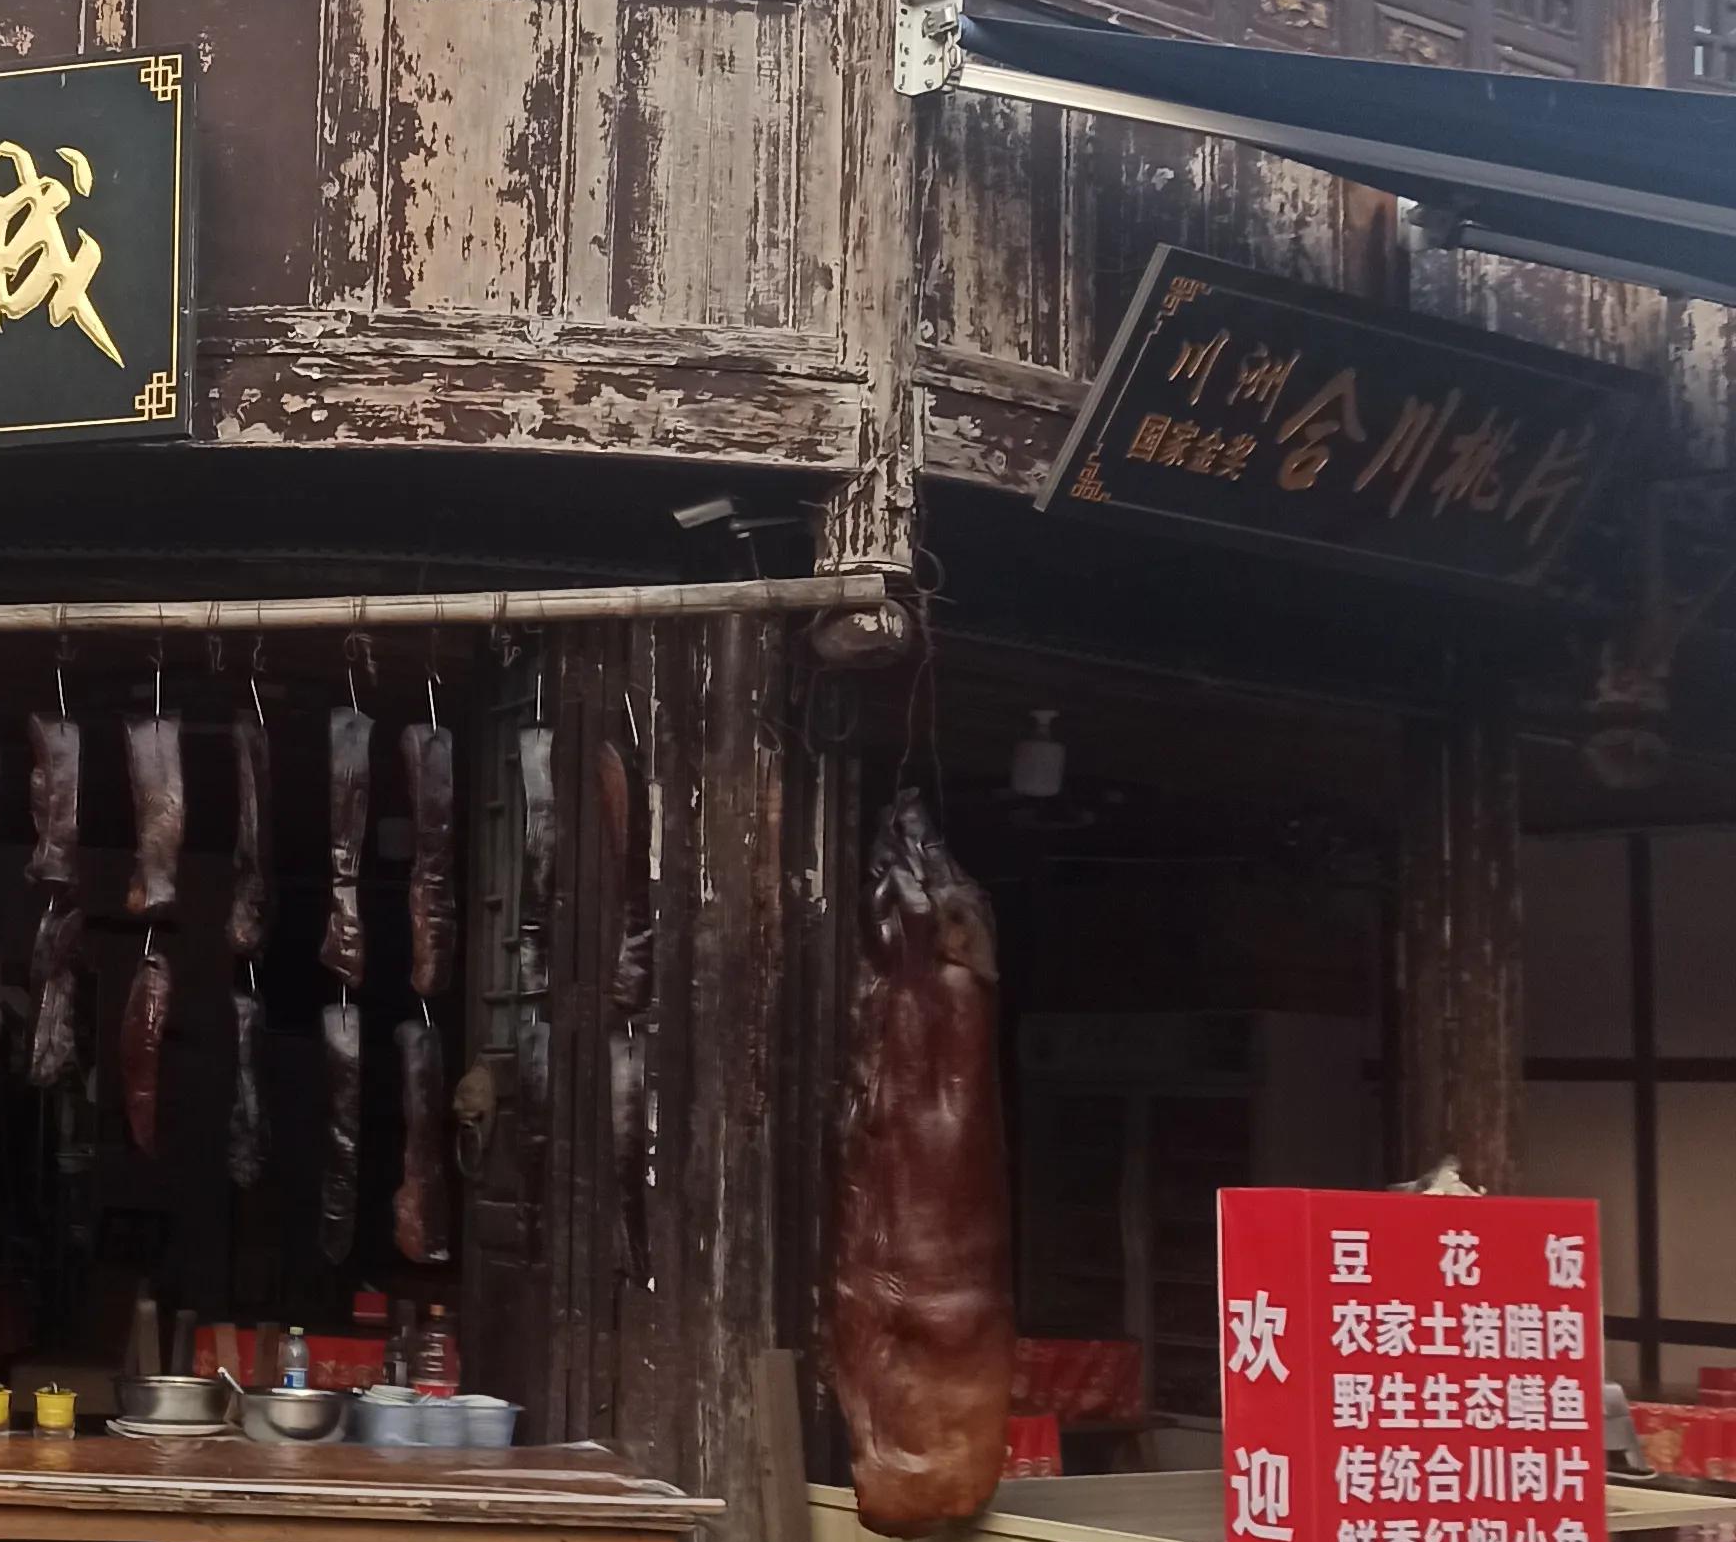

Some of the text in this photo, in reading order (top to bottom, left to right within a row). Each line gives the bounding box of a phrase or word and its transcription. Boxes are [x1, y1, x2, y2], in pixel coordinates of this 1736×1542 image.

[1331, 1300, 1585, 1360] 农家土猪腊肉
[1332, 1372, 1589, 1431] 野生生态鳝鱼
[1335, 1444, 1590, 1503] 传统合川肉片
